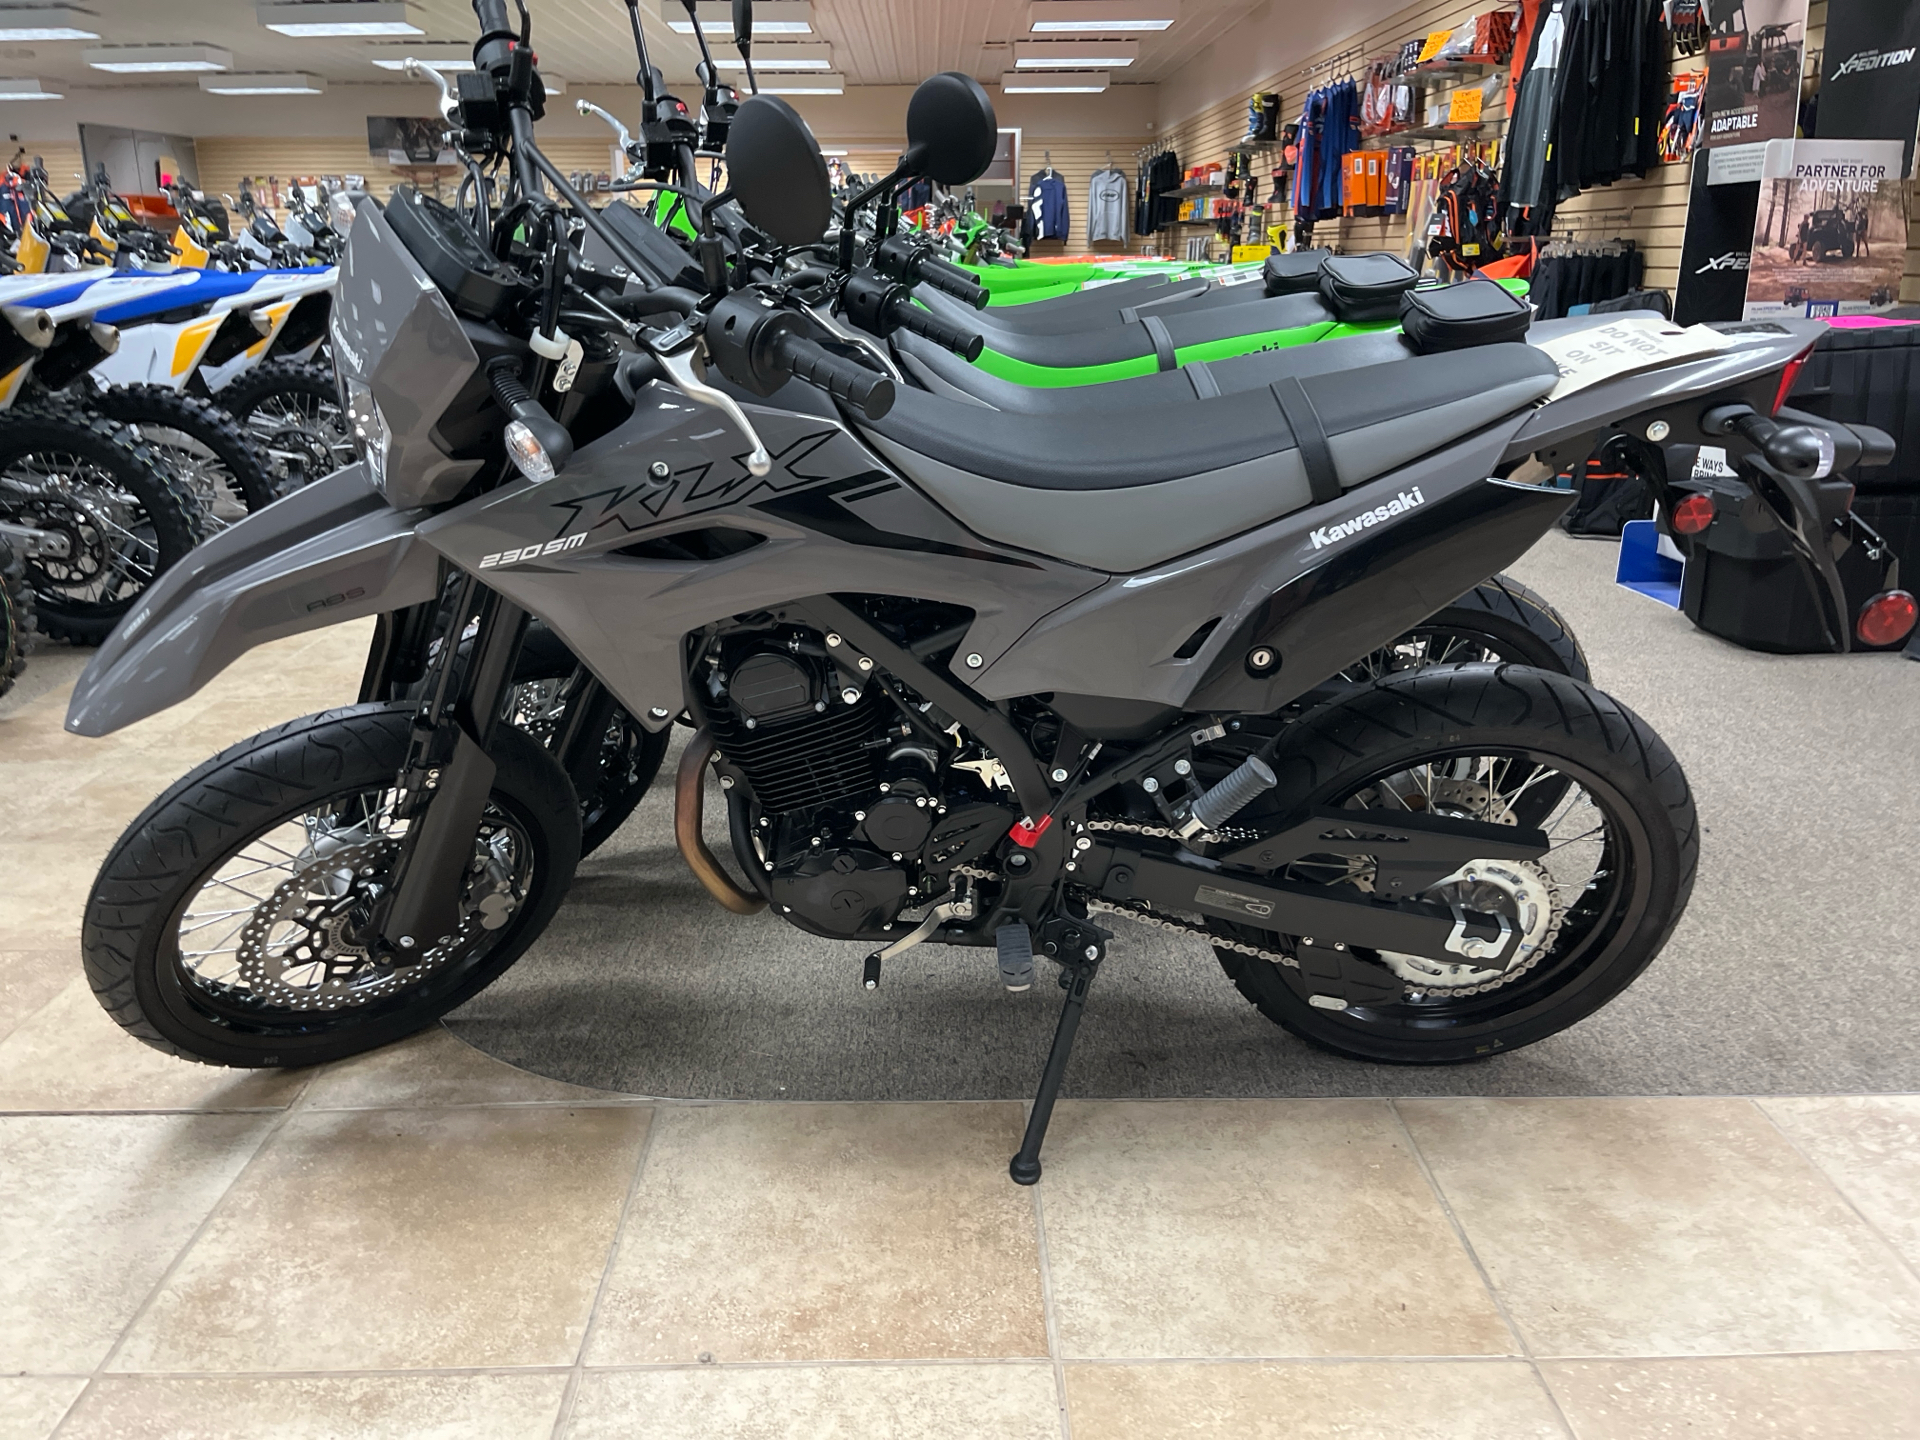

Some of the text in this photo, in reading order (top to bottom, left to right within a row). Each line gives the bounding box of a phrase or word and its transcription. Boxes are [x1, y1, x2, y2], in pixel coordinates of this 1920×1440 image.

[1830, 47, 1916, 81] XPEDITION
[1711, 113, 1758, 133] ADAPTABLE
[1796, 164, 1886, 178] PARTNER FOR
[1800, 179, 1879, 193] ADVENTURE
[1589, 341, 1625, 355] SIT
[1598, 327, 1669, 356] DO NOT
[1566, 350, 1597, 364] ON
[1702, 457, 1724, 473] WAYS
[1309, 486, 1426, 550] Kawasaki
[307, 586, 366, 612] ABS
